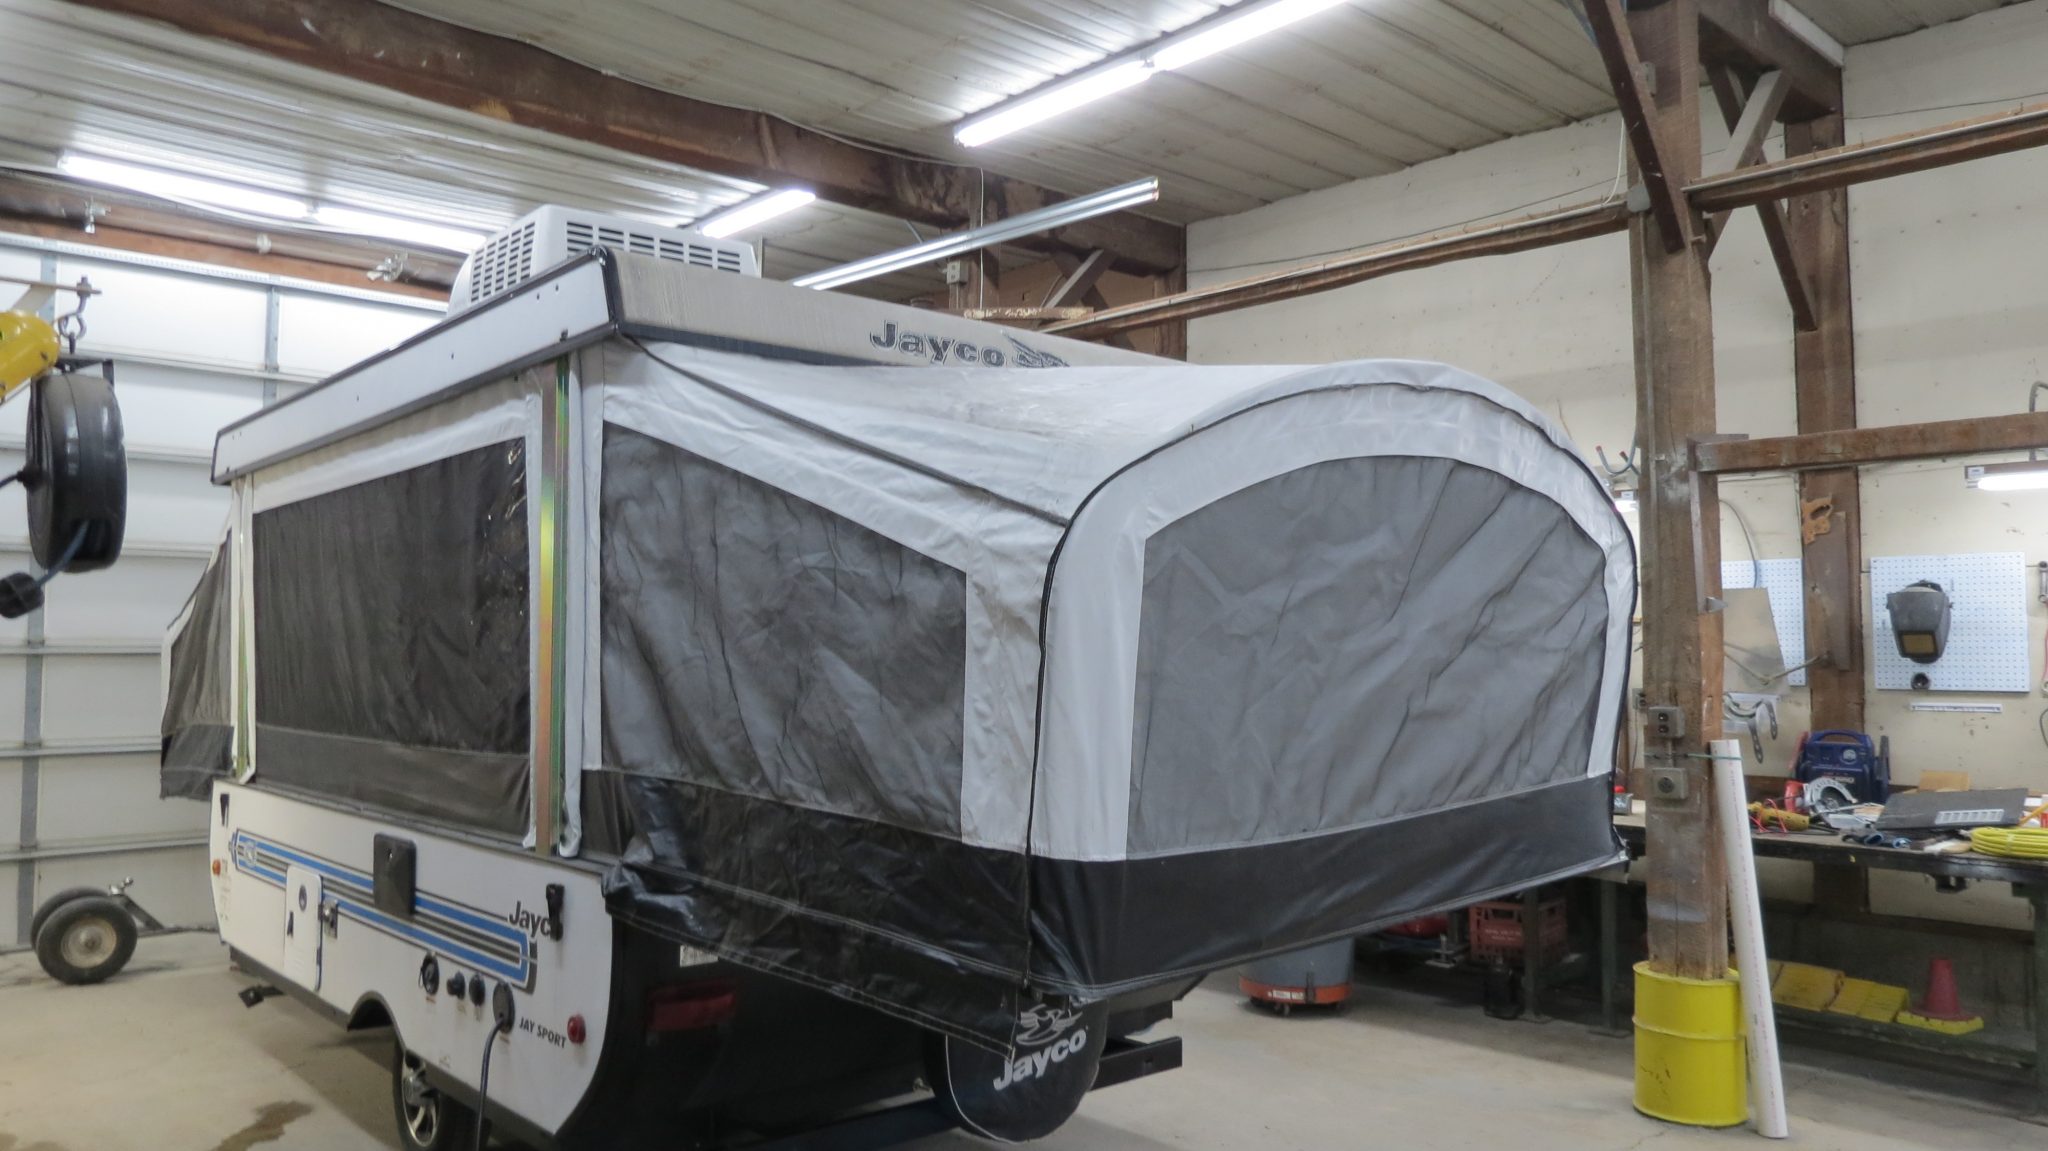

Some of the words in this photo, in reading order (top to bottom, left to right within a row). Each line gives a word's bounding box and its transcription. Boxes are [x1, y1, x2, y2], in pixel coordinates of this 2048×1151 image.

[870, 319, 1007, 367] Jayco
[519, 1016, 535, 1033] JAY
[537, 1024, 567, 1048] SPORT
[993, 1029, 1087, 1091] Jayco
